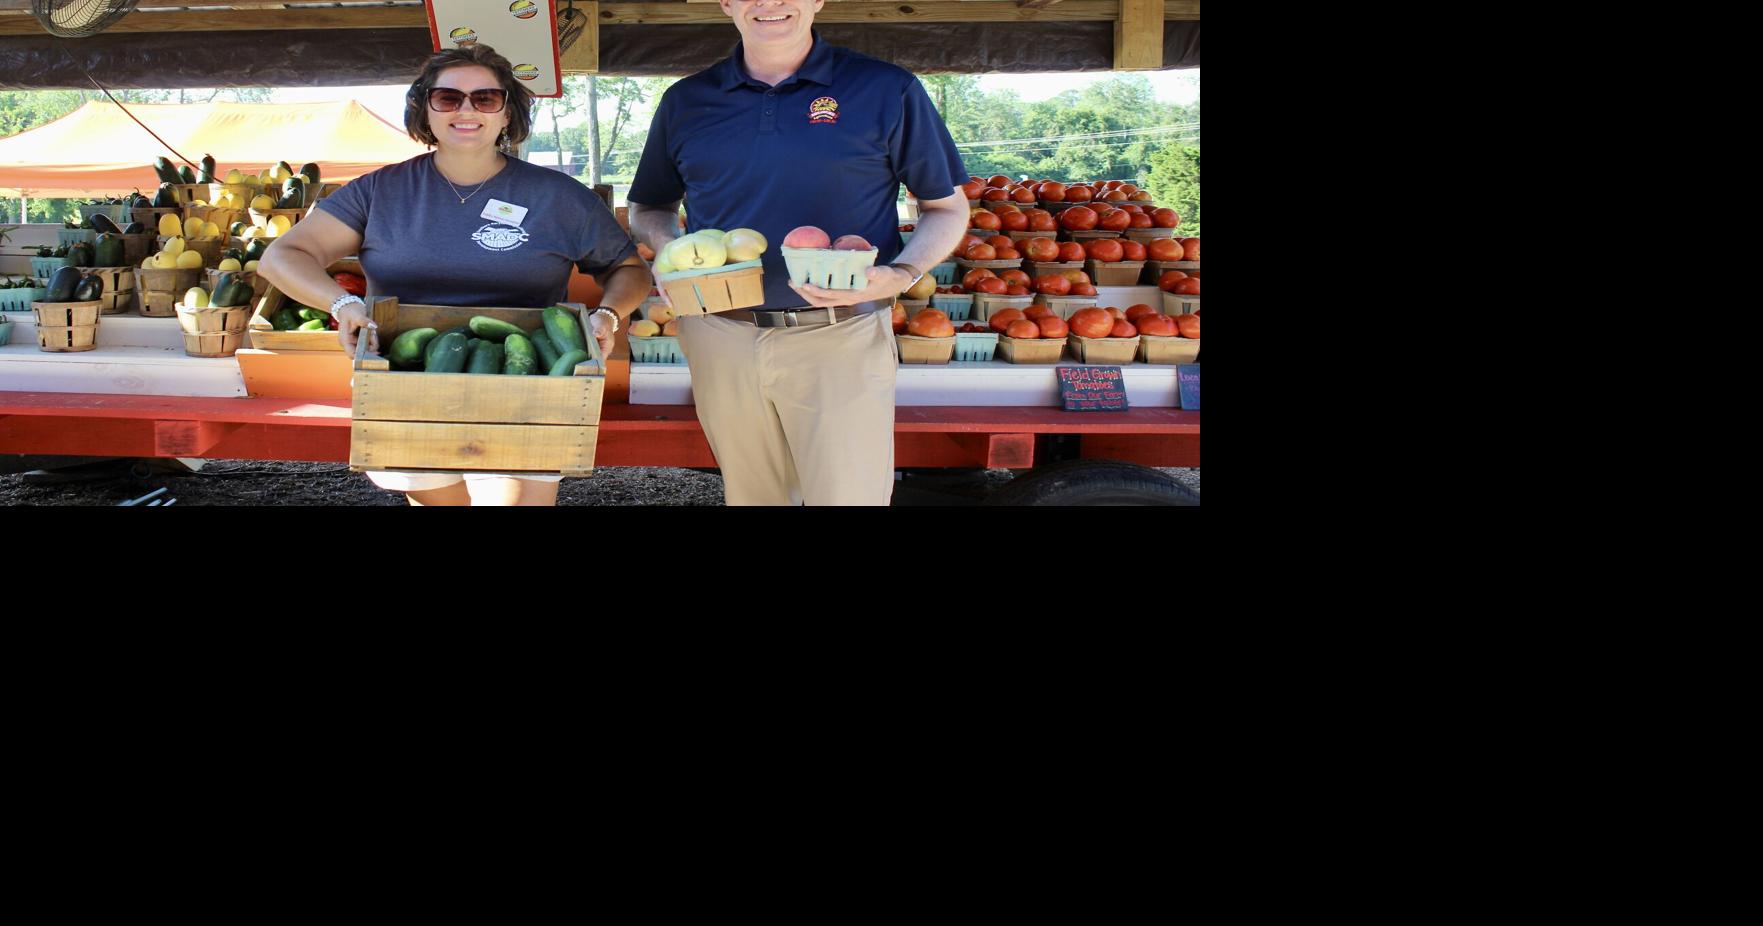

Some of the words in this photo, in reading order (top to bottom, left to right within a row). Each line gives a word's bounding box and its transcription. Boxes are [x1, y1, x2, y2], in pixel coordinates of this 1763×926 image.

[471, 232, 530, 242] SMADC
[1060, 368, 1090, 381] Field
[1092, 369, 1122, 380] Grown
[1179, 372, 1201, 382] Loca
[1068, 380, 1114, 391] Tomatoes
